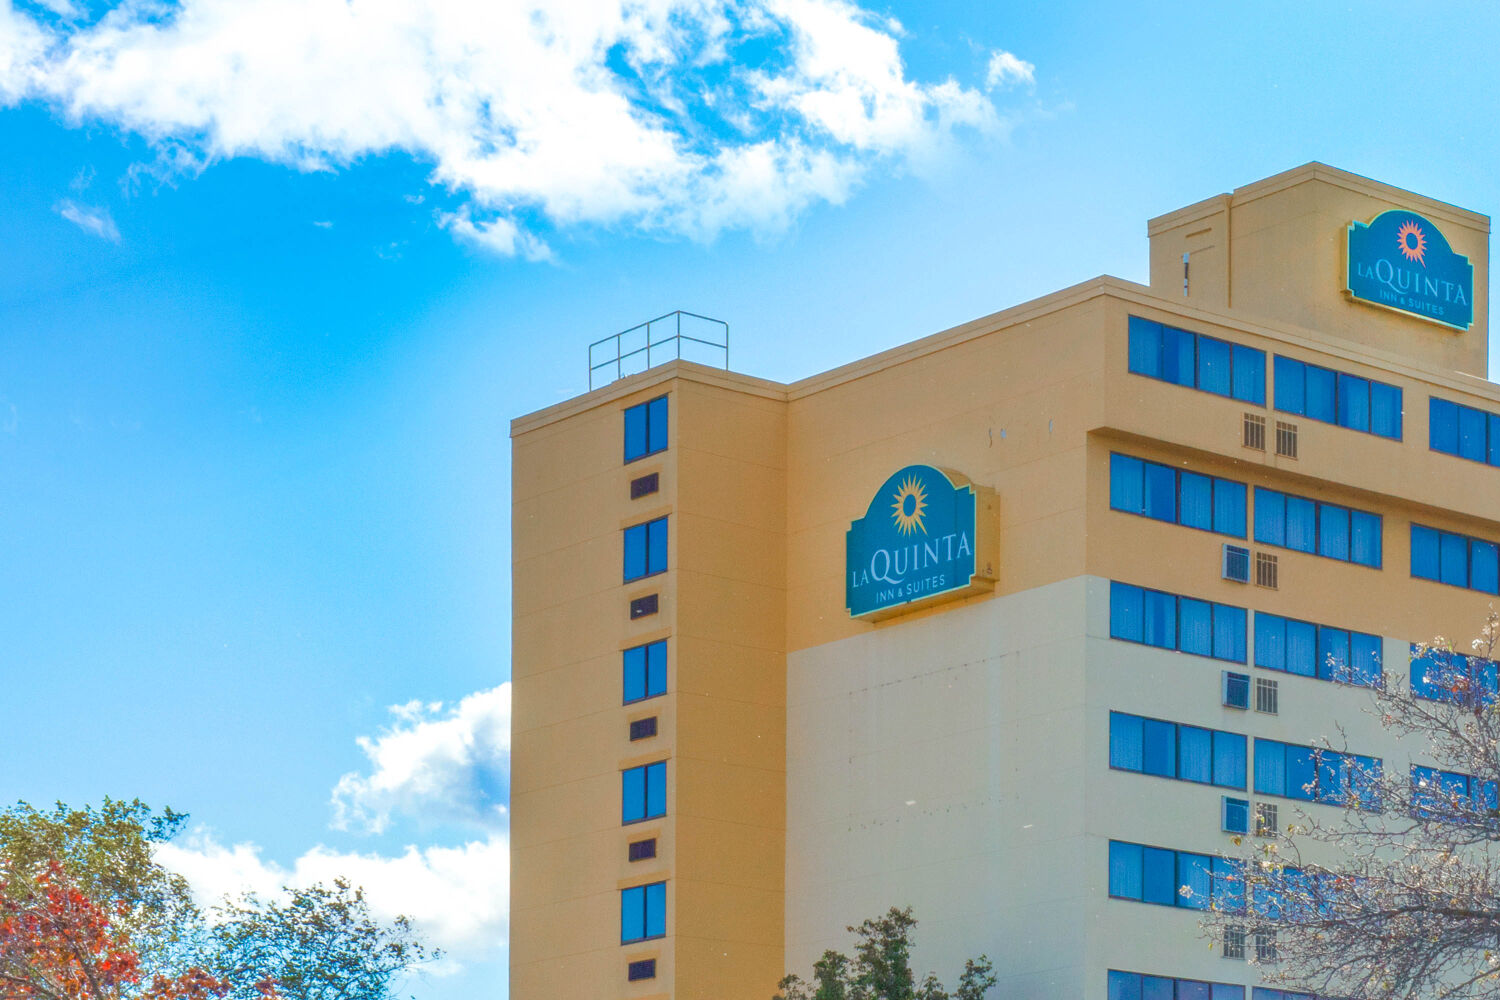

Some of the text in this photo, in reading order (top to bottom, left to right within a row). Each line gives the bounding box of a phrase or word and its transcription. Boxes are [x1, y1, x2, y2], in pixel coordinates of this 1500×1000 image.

[1375, 258, 1468, 306] QUINTA
[1380, 290, 1444, 315] INN & SUITES
[870, 531, 972, 584] QUINTA
[876, 574, 945, 604] INN & SUITES
